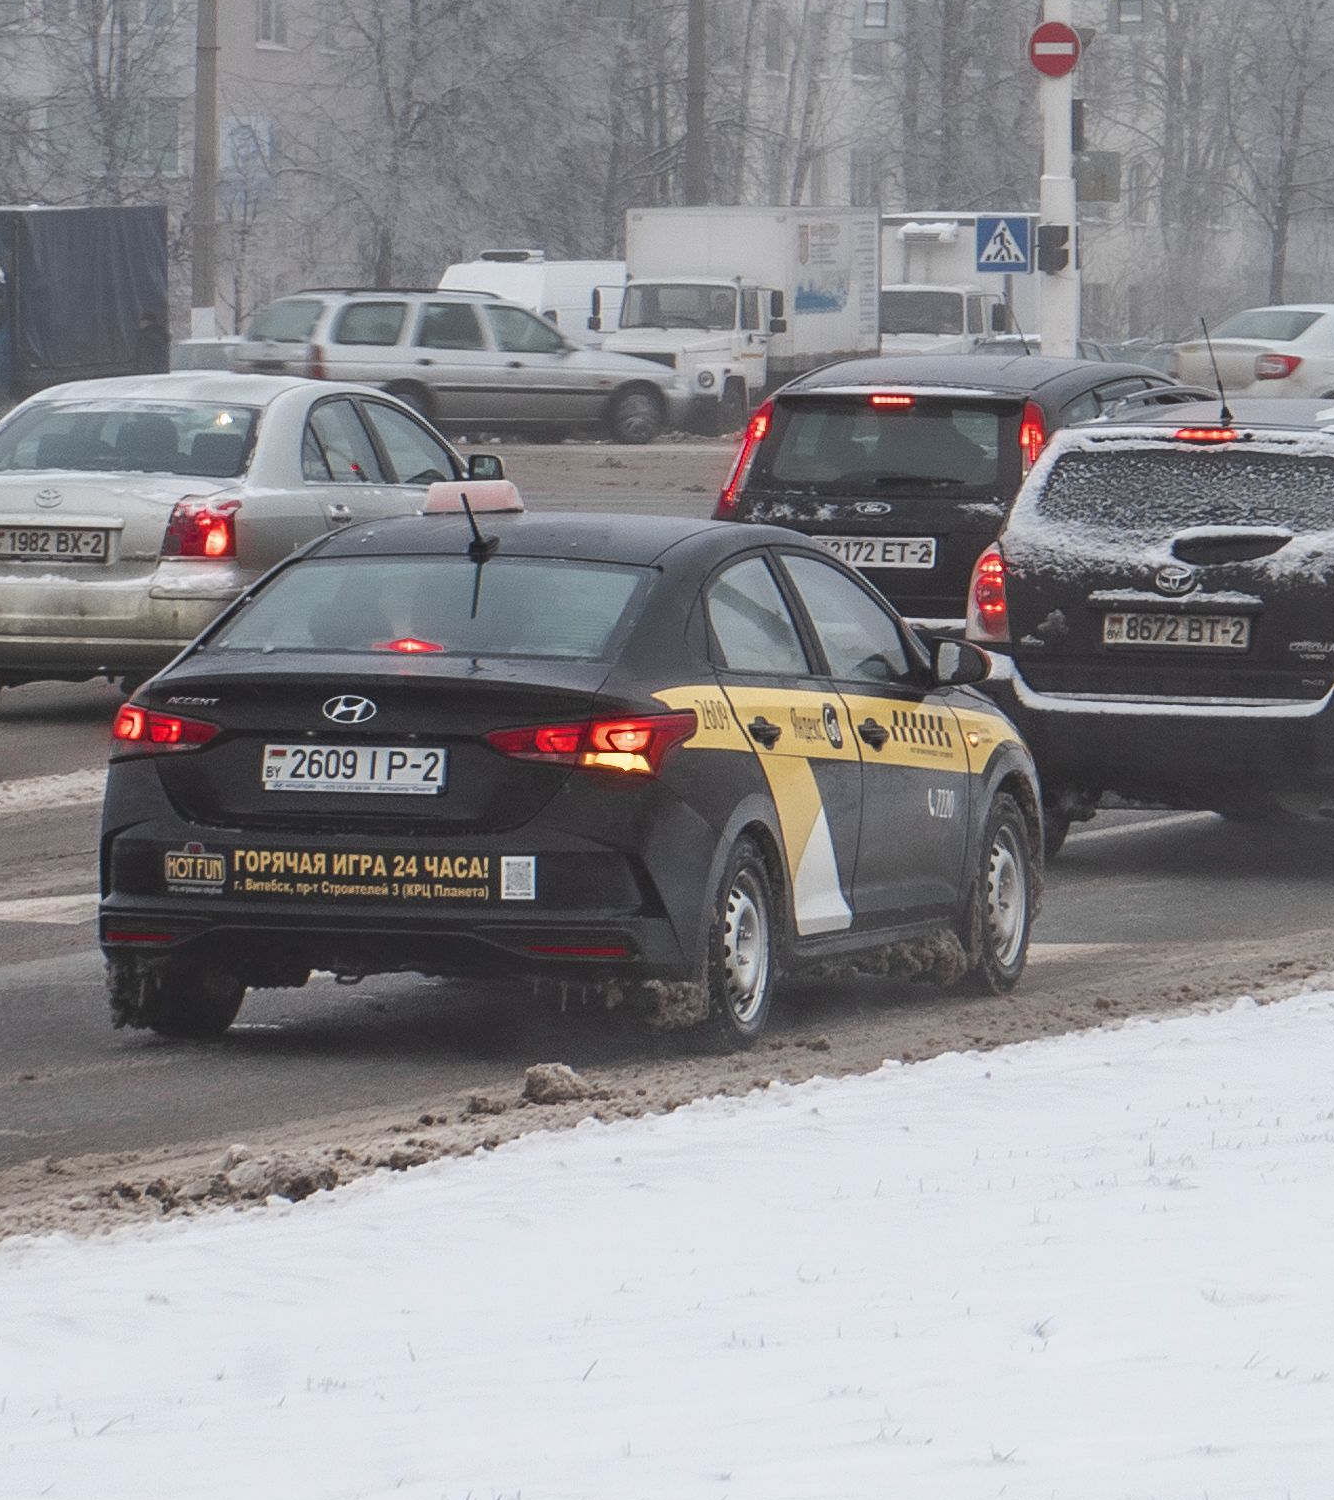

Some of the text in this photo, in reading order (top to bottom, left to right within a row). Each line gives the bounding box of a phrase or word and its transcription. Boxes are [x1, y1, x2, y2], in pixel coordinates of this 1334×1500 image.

[9, 532, 103, 554] 1982 BX-2
[881, 542, 932, 563] ET-2
[1126, 617, 1245, 645] 8672 BT-2
[166, 696, 219, 706] ACCENT
[694, 699, 730, 730] 2609
[266, 766, 282, 778] BY
[289, 749, 358, 779] 2609
[167, 856, 223, 880] HOT FUN
[234, 850, 489, 878] ГОРЯЧАЯ ИГРА 24 ЧАСА!
[245, 878, 294, 895] Витебск,
[296, 883, 319, 895] пр-т
[321, 881, 388, 897] Строителей
[392, 883, 400, 896] 3
[402, 883, 431, 899] (КРЦ
[434, 884, 489, 900] Планета)
